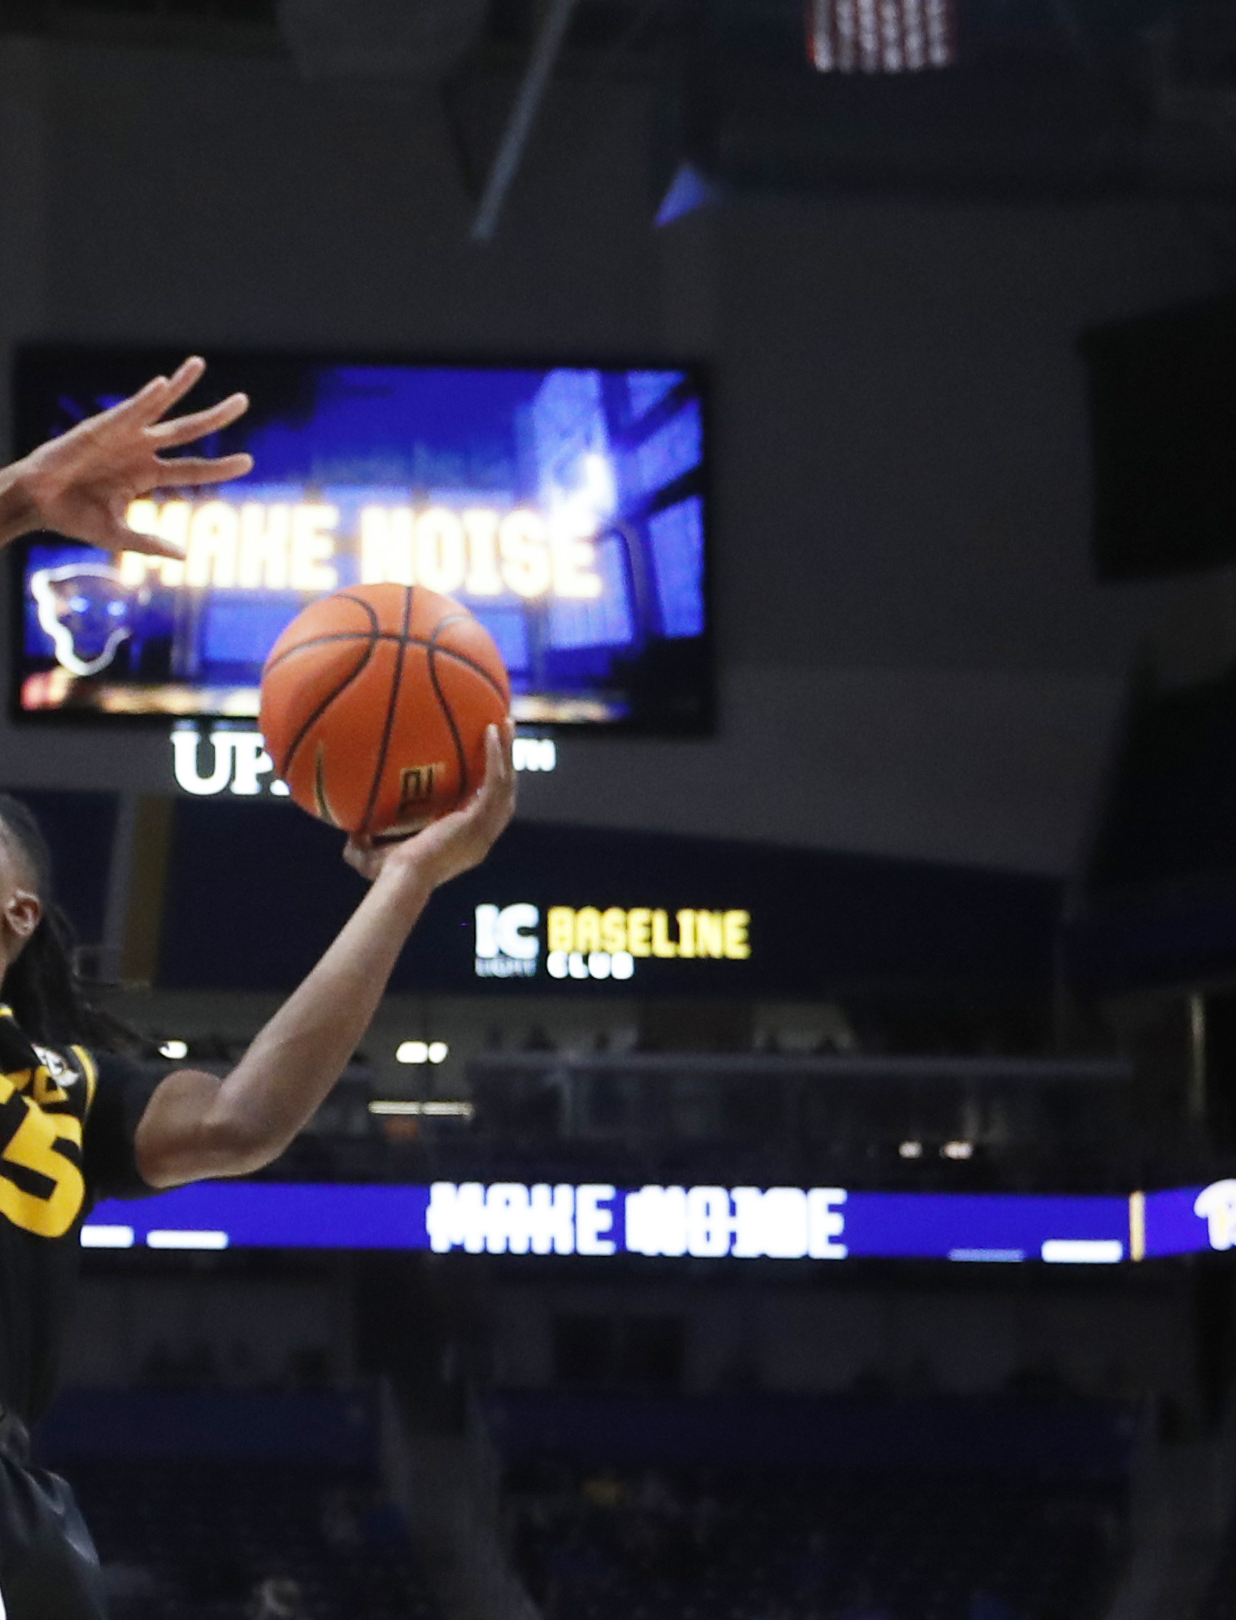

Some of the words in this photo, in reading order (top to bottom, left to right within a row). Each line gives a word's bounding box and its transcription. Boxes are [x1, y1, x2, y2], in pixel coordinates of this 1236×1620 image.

[361, 506, 604, 599] NOISE
[170, 730, 291, 796] UP
[547, 906, 752, 959] BASELINE
